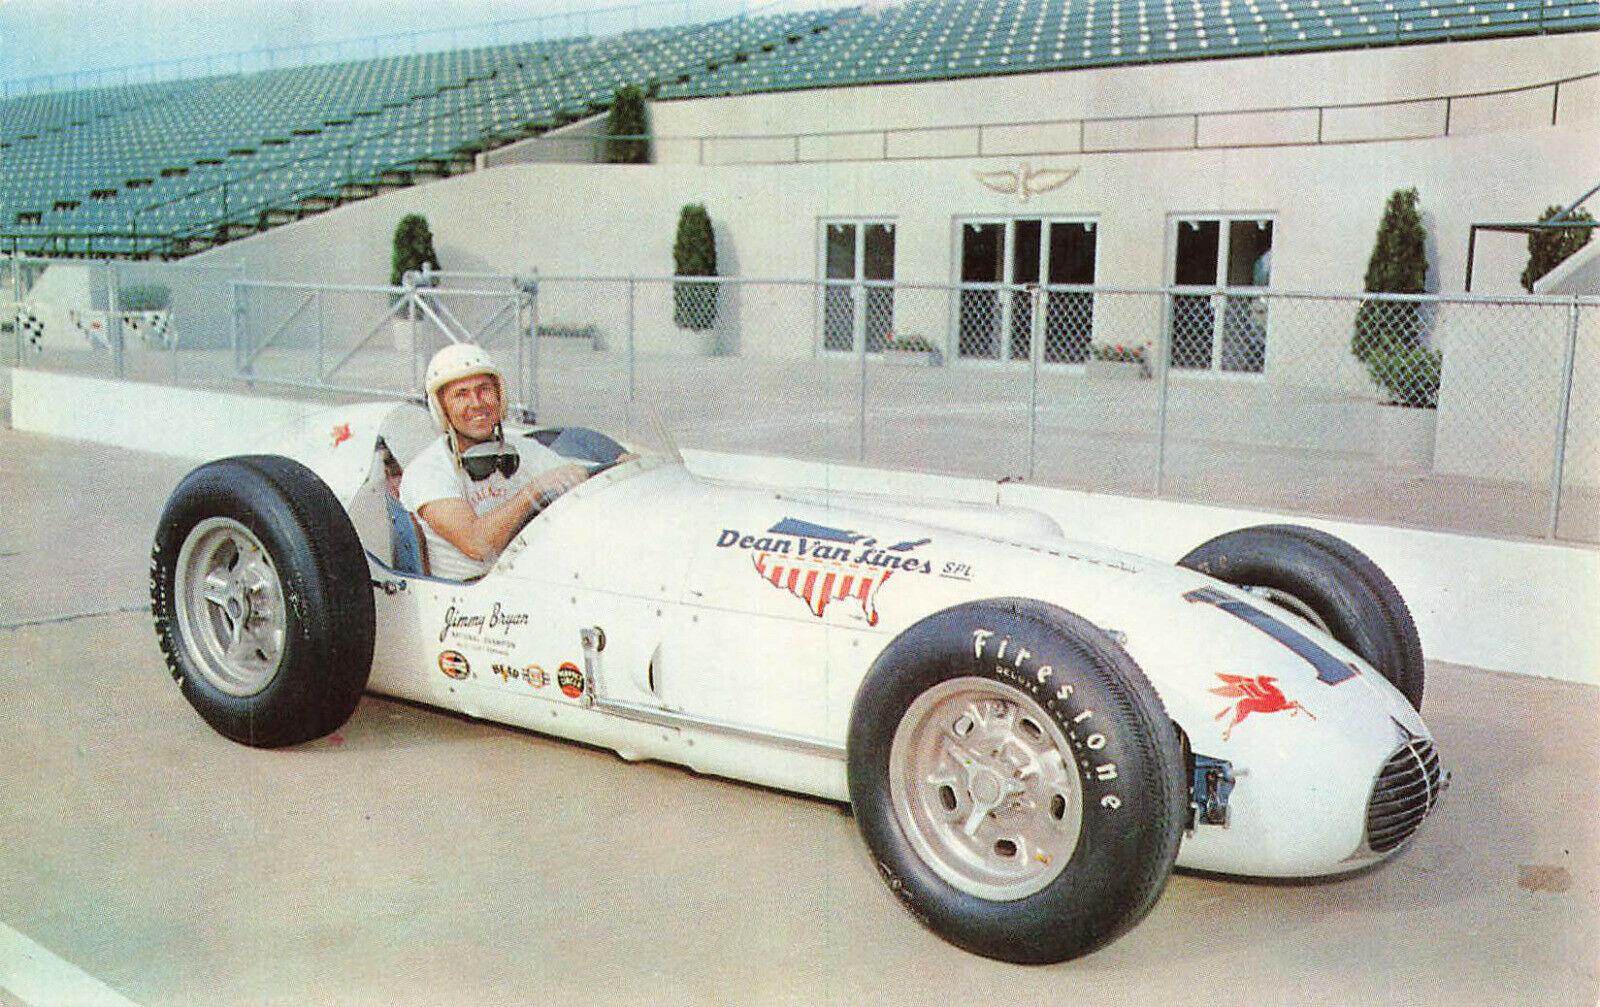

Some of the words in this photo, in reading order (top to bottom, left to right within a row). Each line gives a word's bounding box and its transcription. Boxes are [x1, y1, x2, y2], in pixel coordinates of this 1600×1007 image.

[716, 528, 792, 555] Dean
[798, 537, 849, 563] Van
[854, 546, 932, 574] Lines
[439, 606, 485, 642] Jimmy
[489, 602, 529, 636] Bryan
[972, 628, 1122, 810] Firestone
